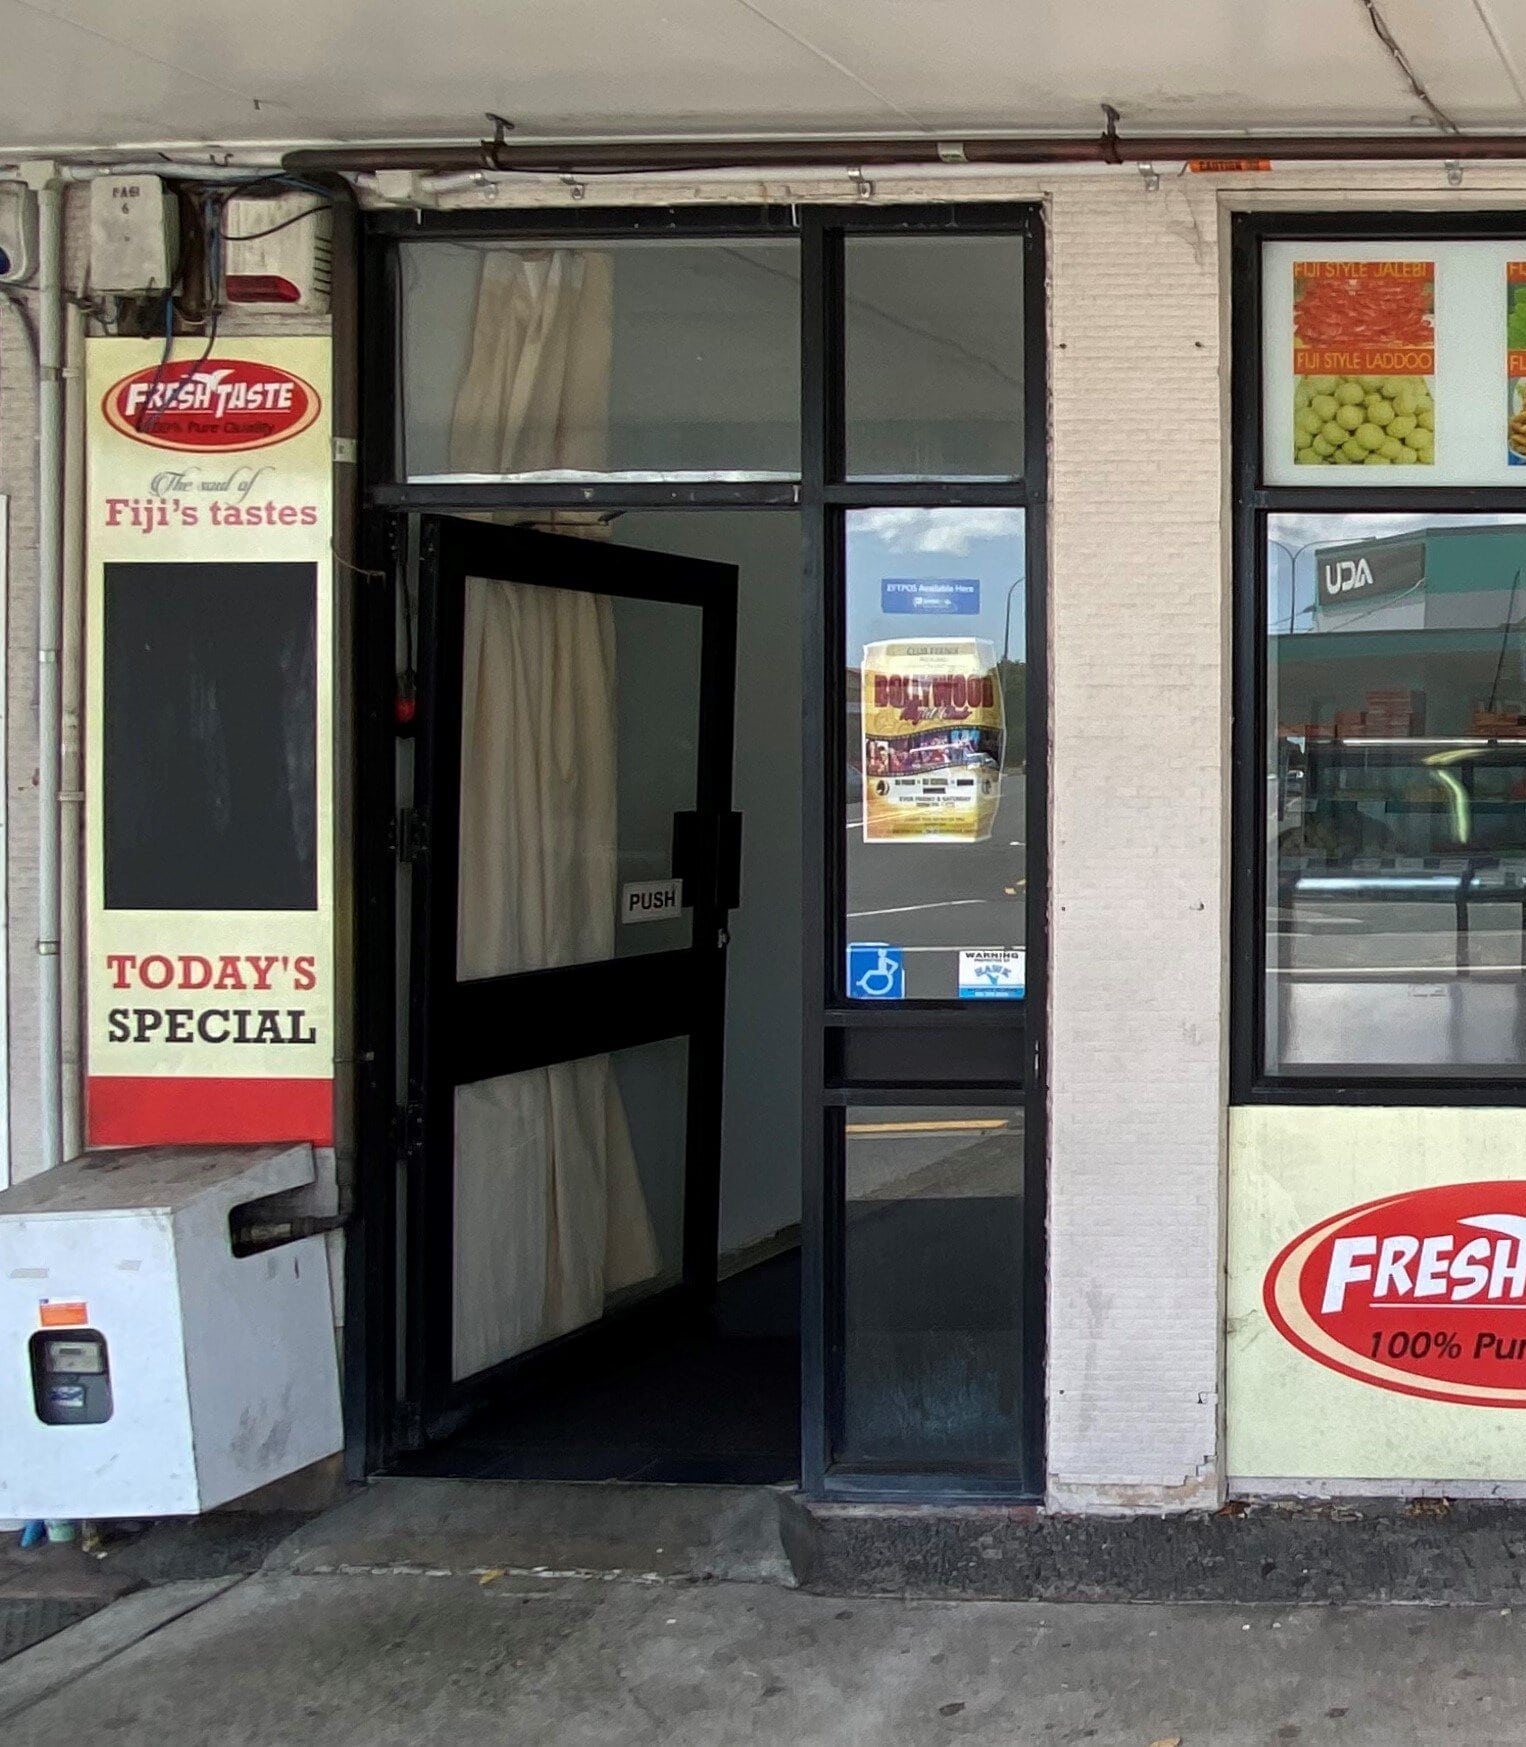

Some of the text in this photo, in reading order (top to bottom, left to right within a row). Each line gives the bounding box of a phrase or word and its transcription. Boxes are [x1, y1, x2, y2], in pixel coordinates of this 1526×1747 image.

[1325, 262, 1368, 277] STYLE
[1374, 262, 1426, 277] JALEBI
[1297, 353, 1432, 369] FIJI STYLE LADDOO
[125, 381, 294, 418] FRESH TASTE
[149, 466, 201, 500] The
[198, 466, 252, 492] soul
[105, 498, 318, 534] Fiji's tastes
[629, 890, 676, 911] PUSH
[106, 954, 317, 991] TODAY'S
[108, 1008, 317, 1045] SPECIAL
[1319, 1233, 1525, 1315] FRESH
[1369, 1330, 1463, 1360] 100%
